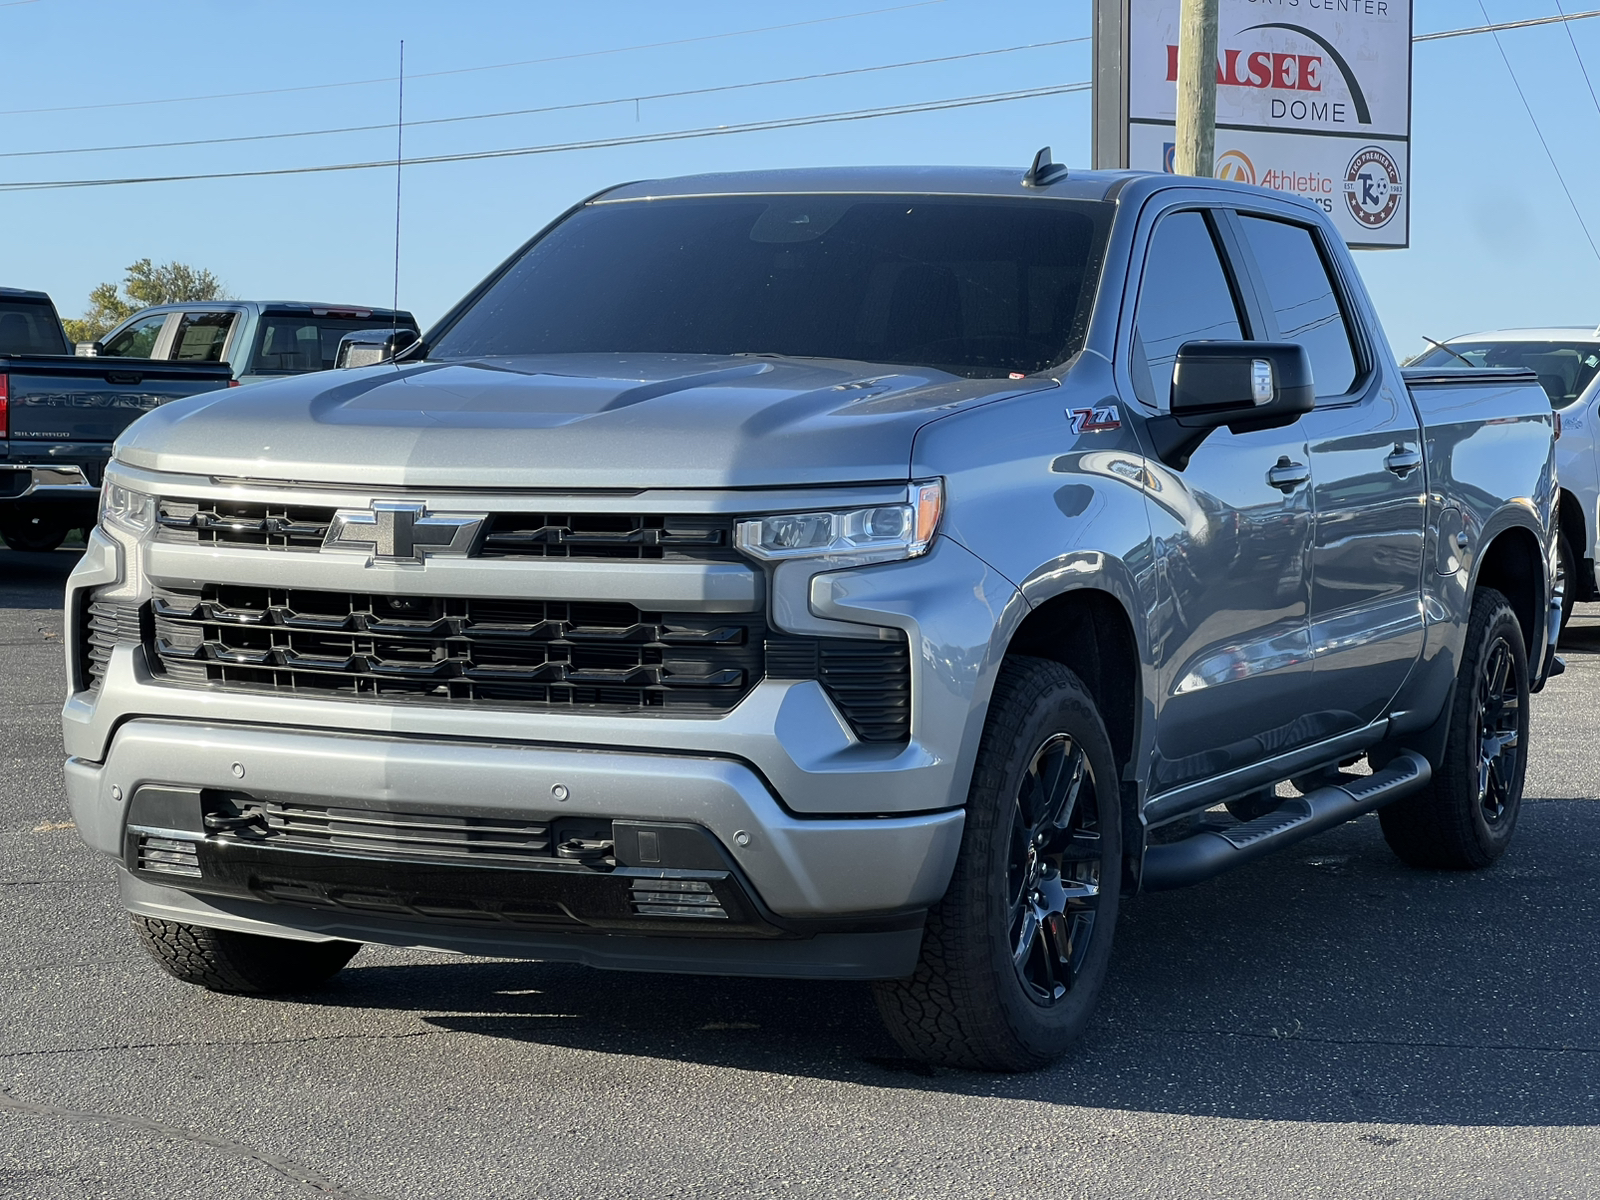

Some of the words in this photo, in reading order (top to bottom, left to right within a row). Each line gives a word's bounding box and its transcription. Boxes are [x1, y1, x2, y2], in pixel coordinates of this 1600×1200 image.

[1309, 0, 1388, 16] CENTER
[1271, 99, 1345, 123] DOME
[1351, 160, 1362, 174] TKO
[1362, 153, 1389, 166] PREMIER
[1260, 169, 1332, 194] Athletic
[1065, 405, 1121, 435] Z71
